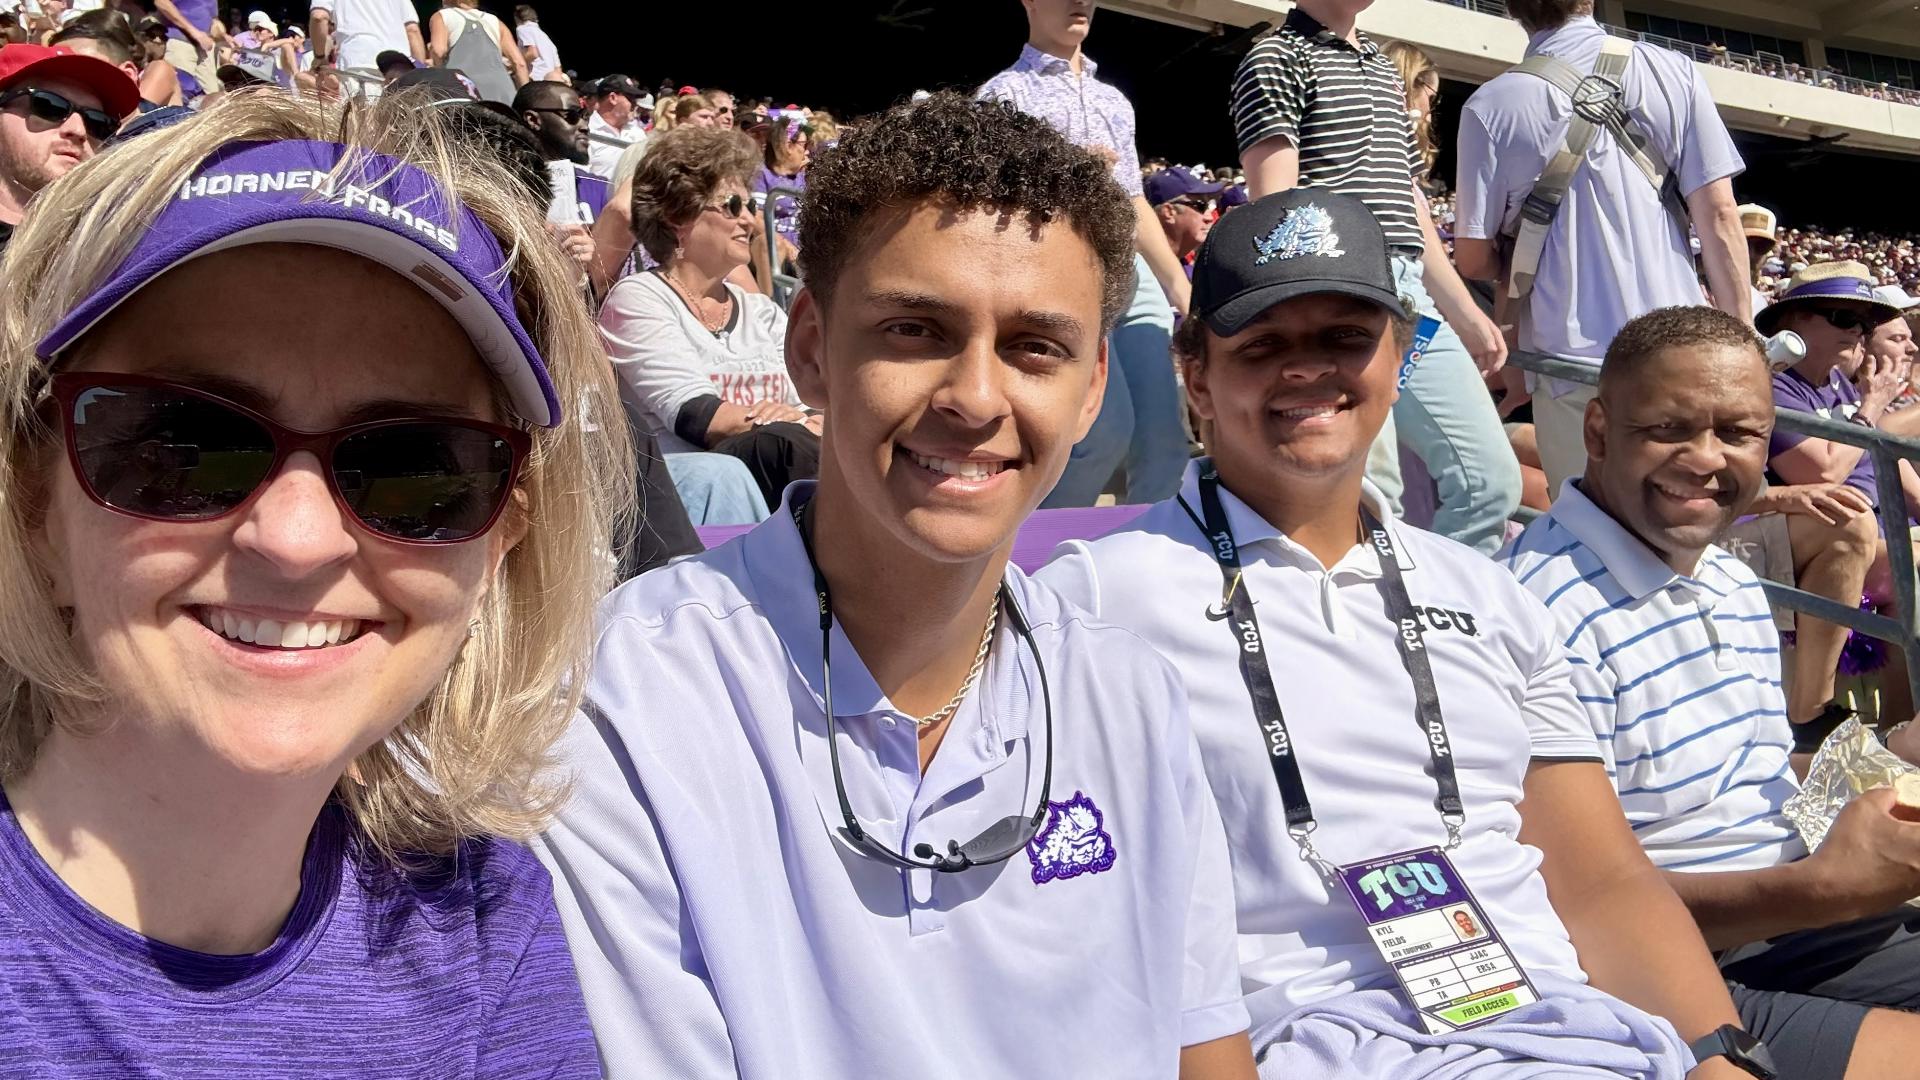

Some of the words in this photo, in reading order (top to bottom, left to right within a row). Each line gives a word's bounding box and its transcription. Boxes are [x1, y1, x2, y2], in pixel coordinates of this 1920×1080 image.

[181, 170, 335, 200] HORNED
[1213, 531, 1234, 560] TCU
[1372, 529, 1394, 557] TCU
[1239, 620, 1260, 653] TCU
[1401, 618, 1424, 652] TCU
[1264, 720, 1289, 757] TCU
[1428, 720, 1450, 758] TCU
[1357, 862, 1449, 912] TCU
[1375, 925, 1394, 937] KYLE
[1382, 936, 1407, 949] FIELDS
[1470, 950, 1490, 961] JJAC
[1476, 962, 1497, 974] ERSA
[1429, 977, 1441, 987] PB
[1437, 990, 1449, 1000] TA
[1461, 1005, 1482, 1018] FIELD
[1482, 997, 1510, 1011] ACCESS
